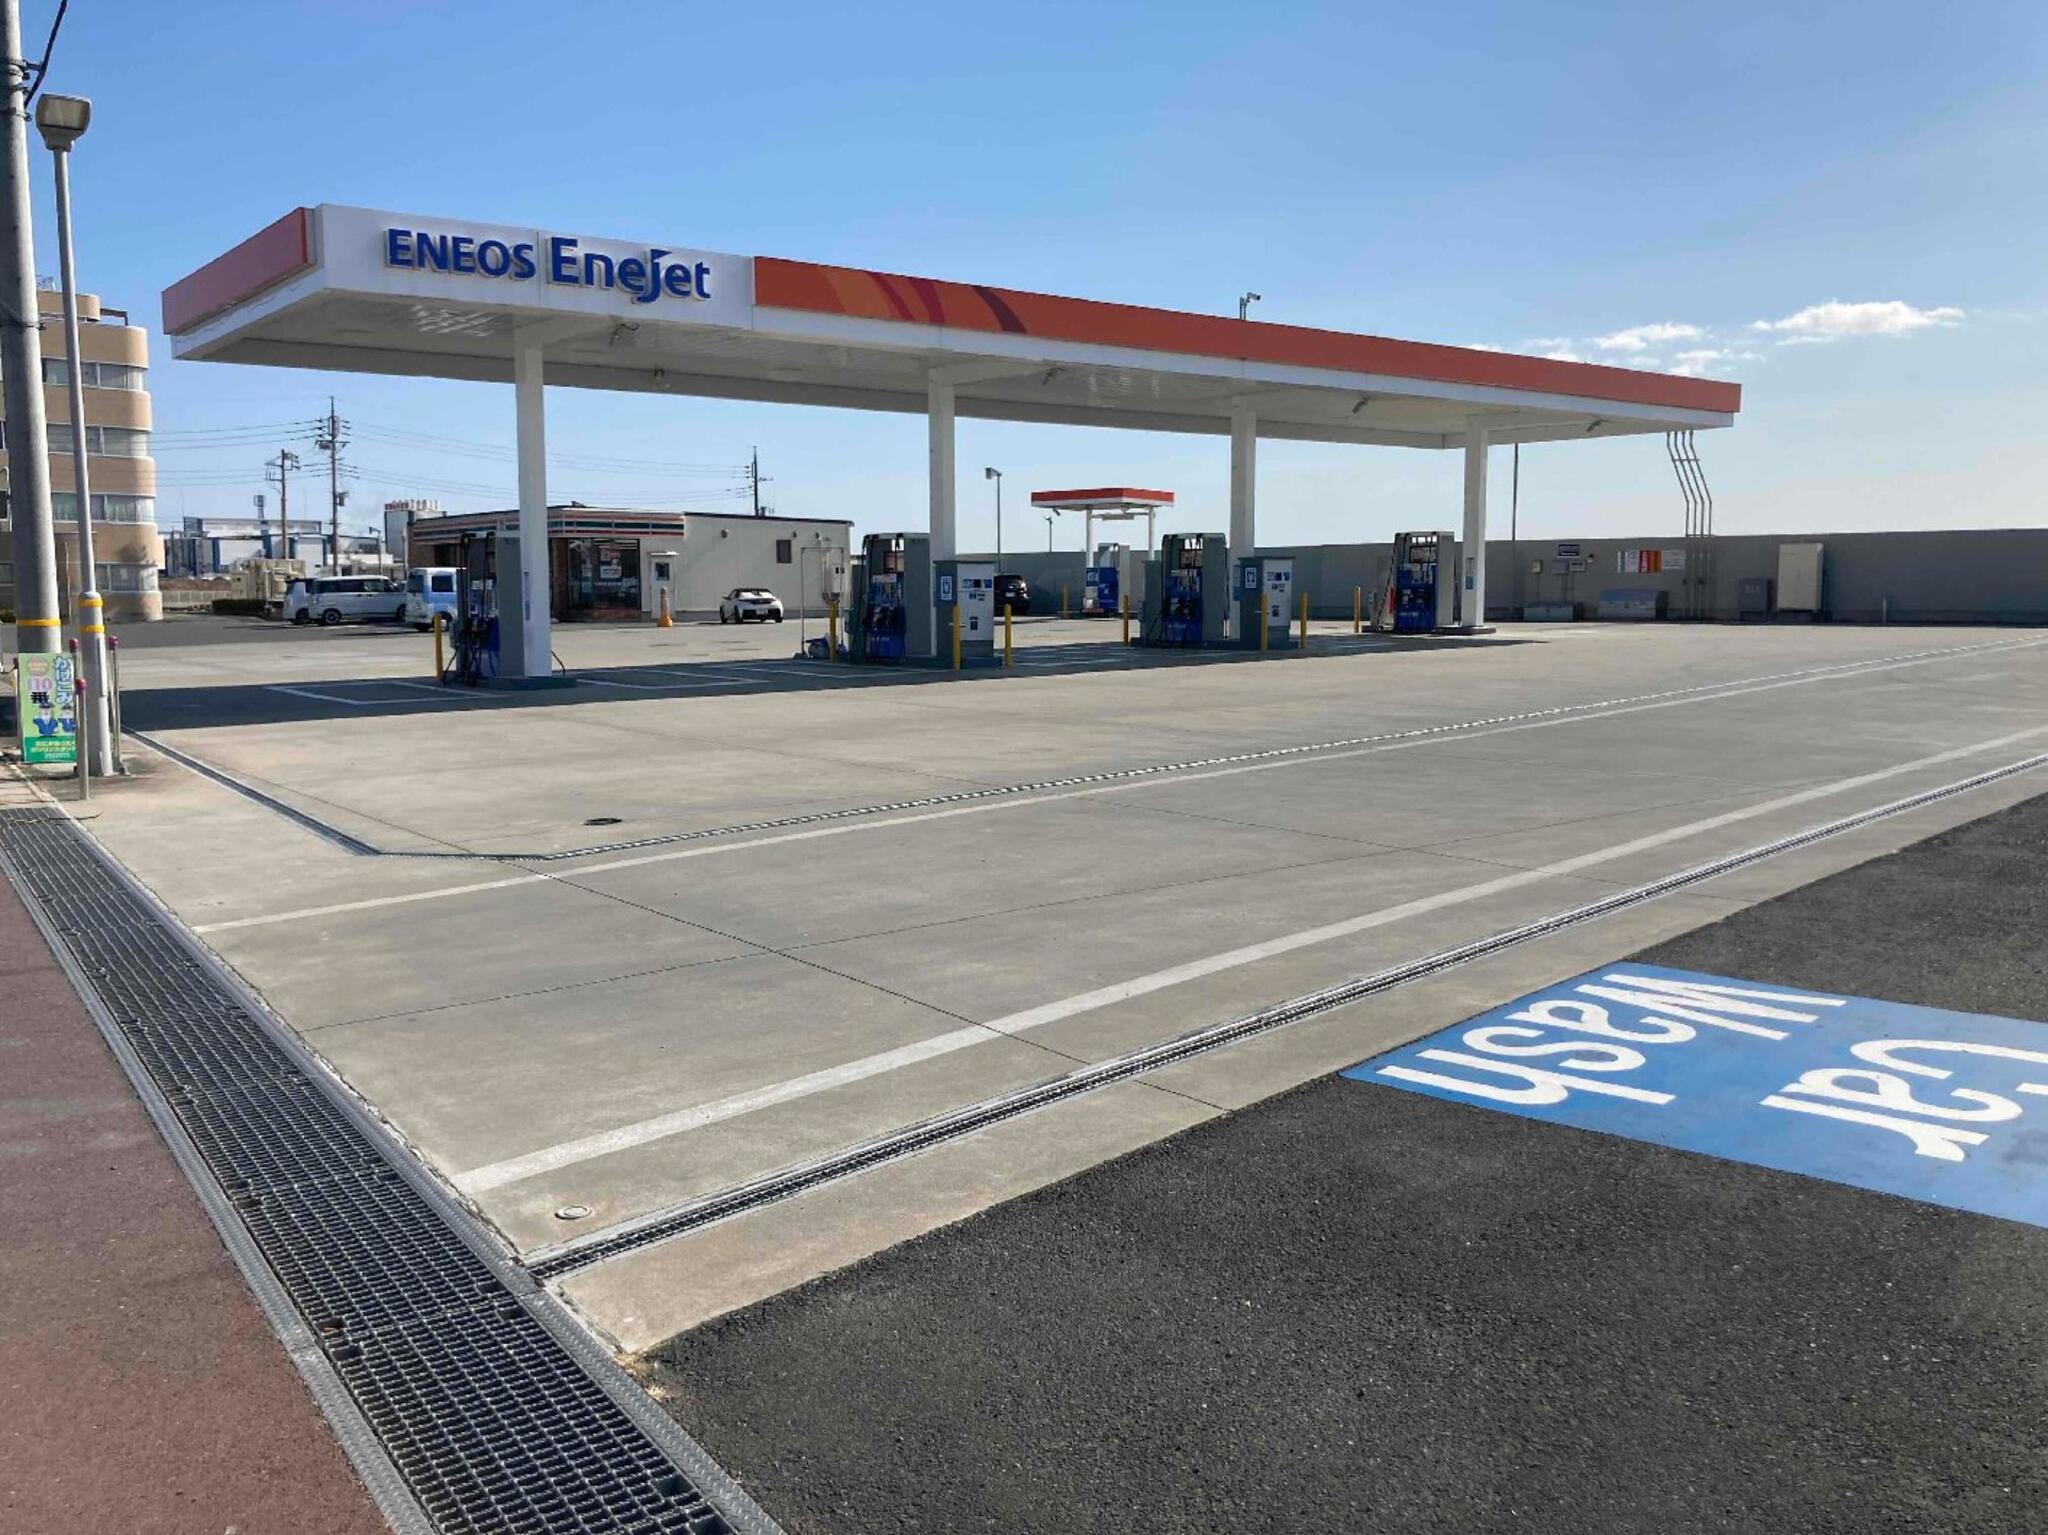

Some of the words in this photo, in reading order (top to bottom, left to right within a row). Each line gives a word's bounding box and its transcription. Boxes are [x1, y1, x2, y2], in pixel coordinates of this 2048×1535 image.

[386, 228, 537, 280] ENEOS
[547, 236, 712, 304] Enejet
[1376, 973, 1847, 1105] Wash
